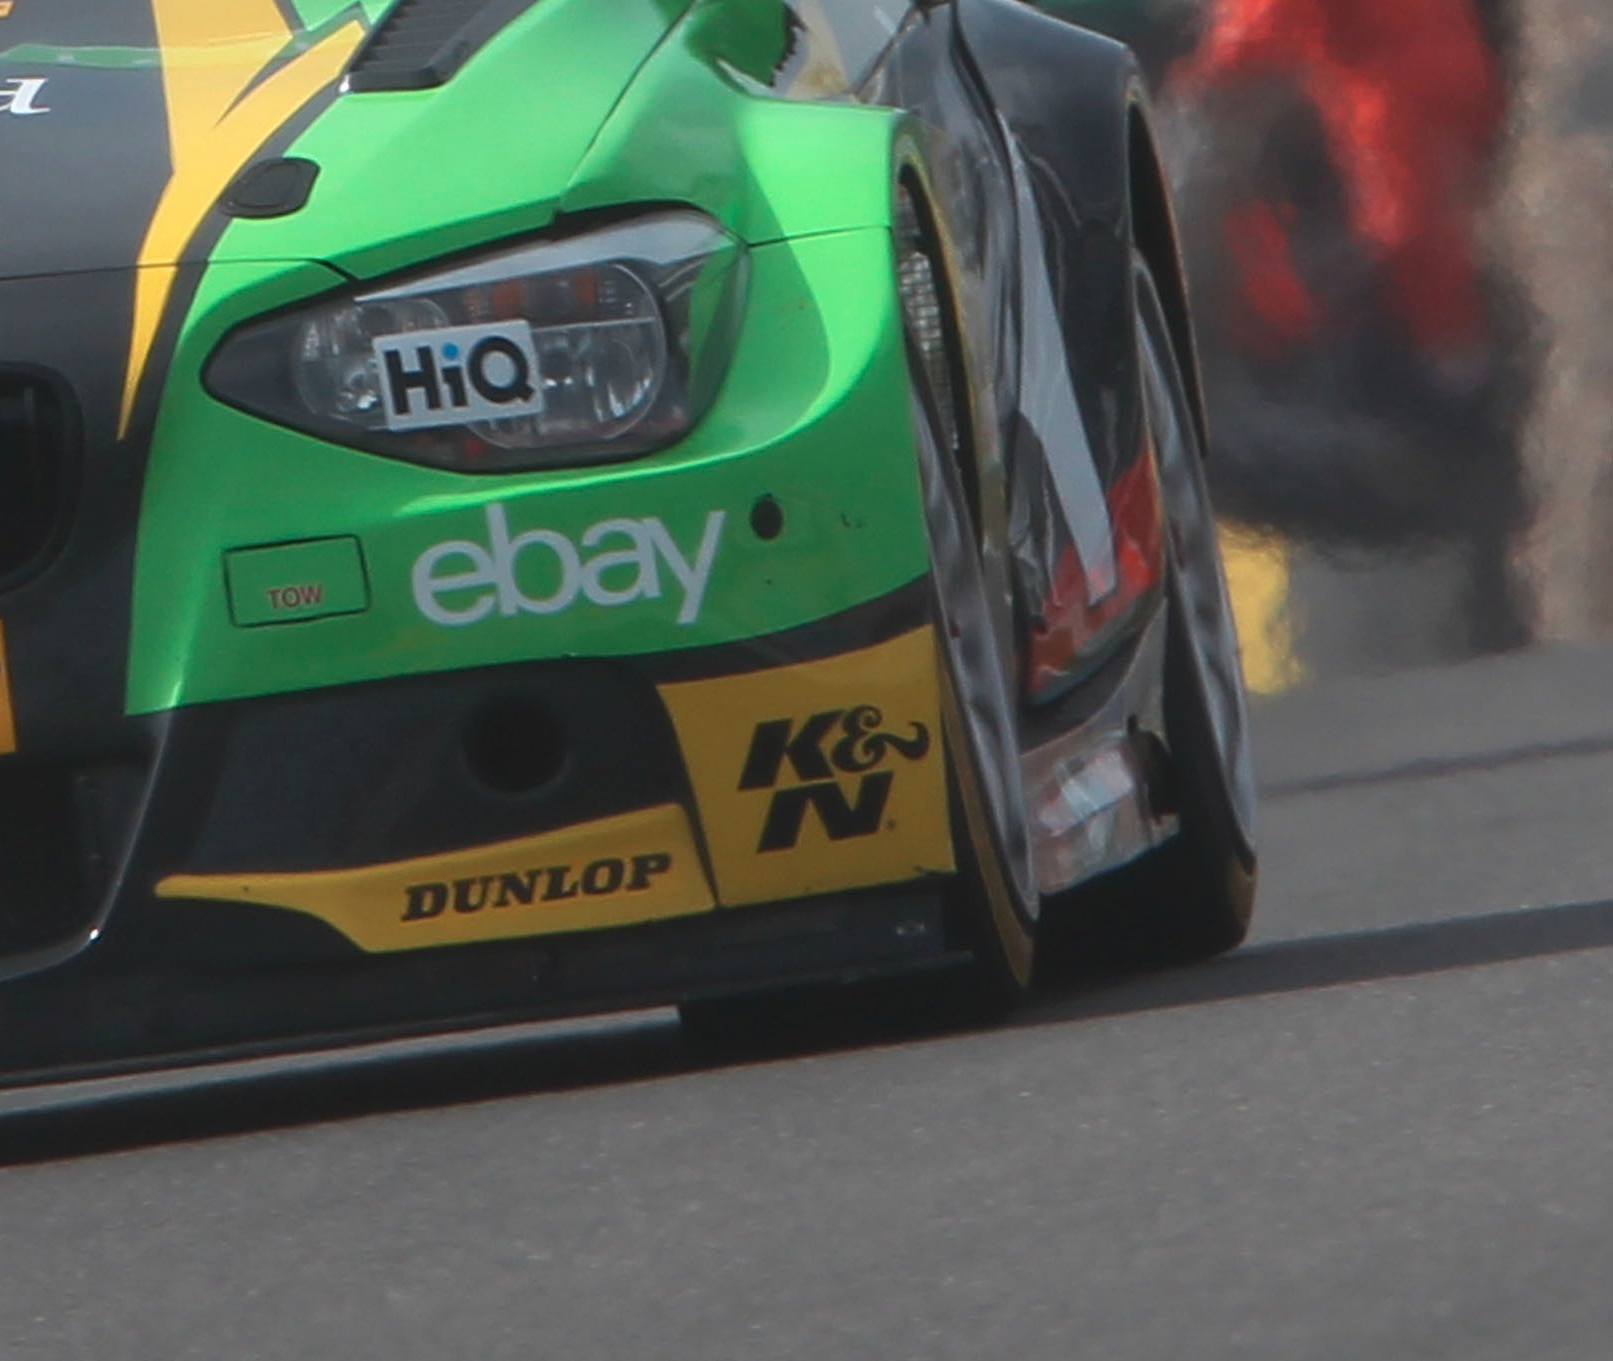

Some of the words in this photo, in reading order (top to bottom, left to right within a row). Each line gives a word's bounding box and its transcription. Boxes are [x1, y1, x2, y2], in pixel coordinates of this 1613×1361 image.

[382, 335, 537, 417] HiQ
[266, 582, 326, 610] TOW
[411, 504, 724, 626] ebay
[401, 852, 672, 923] DUNLOP
